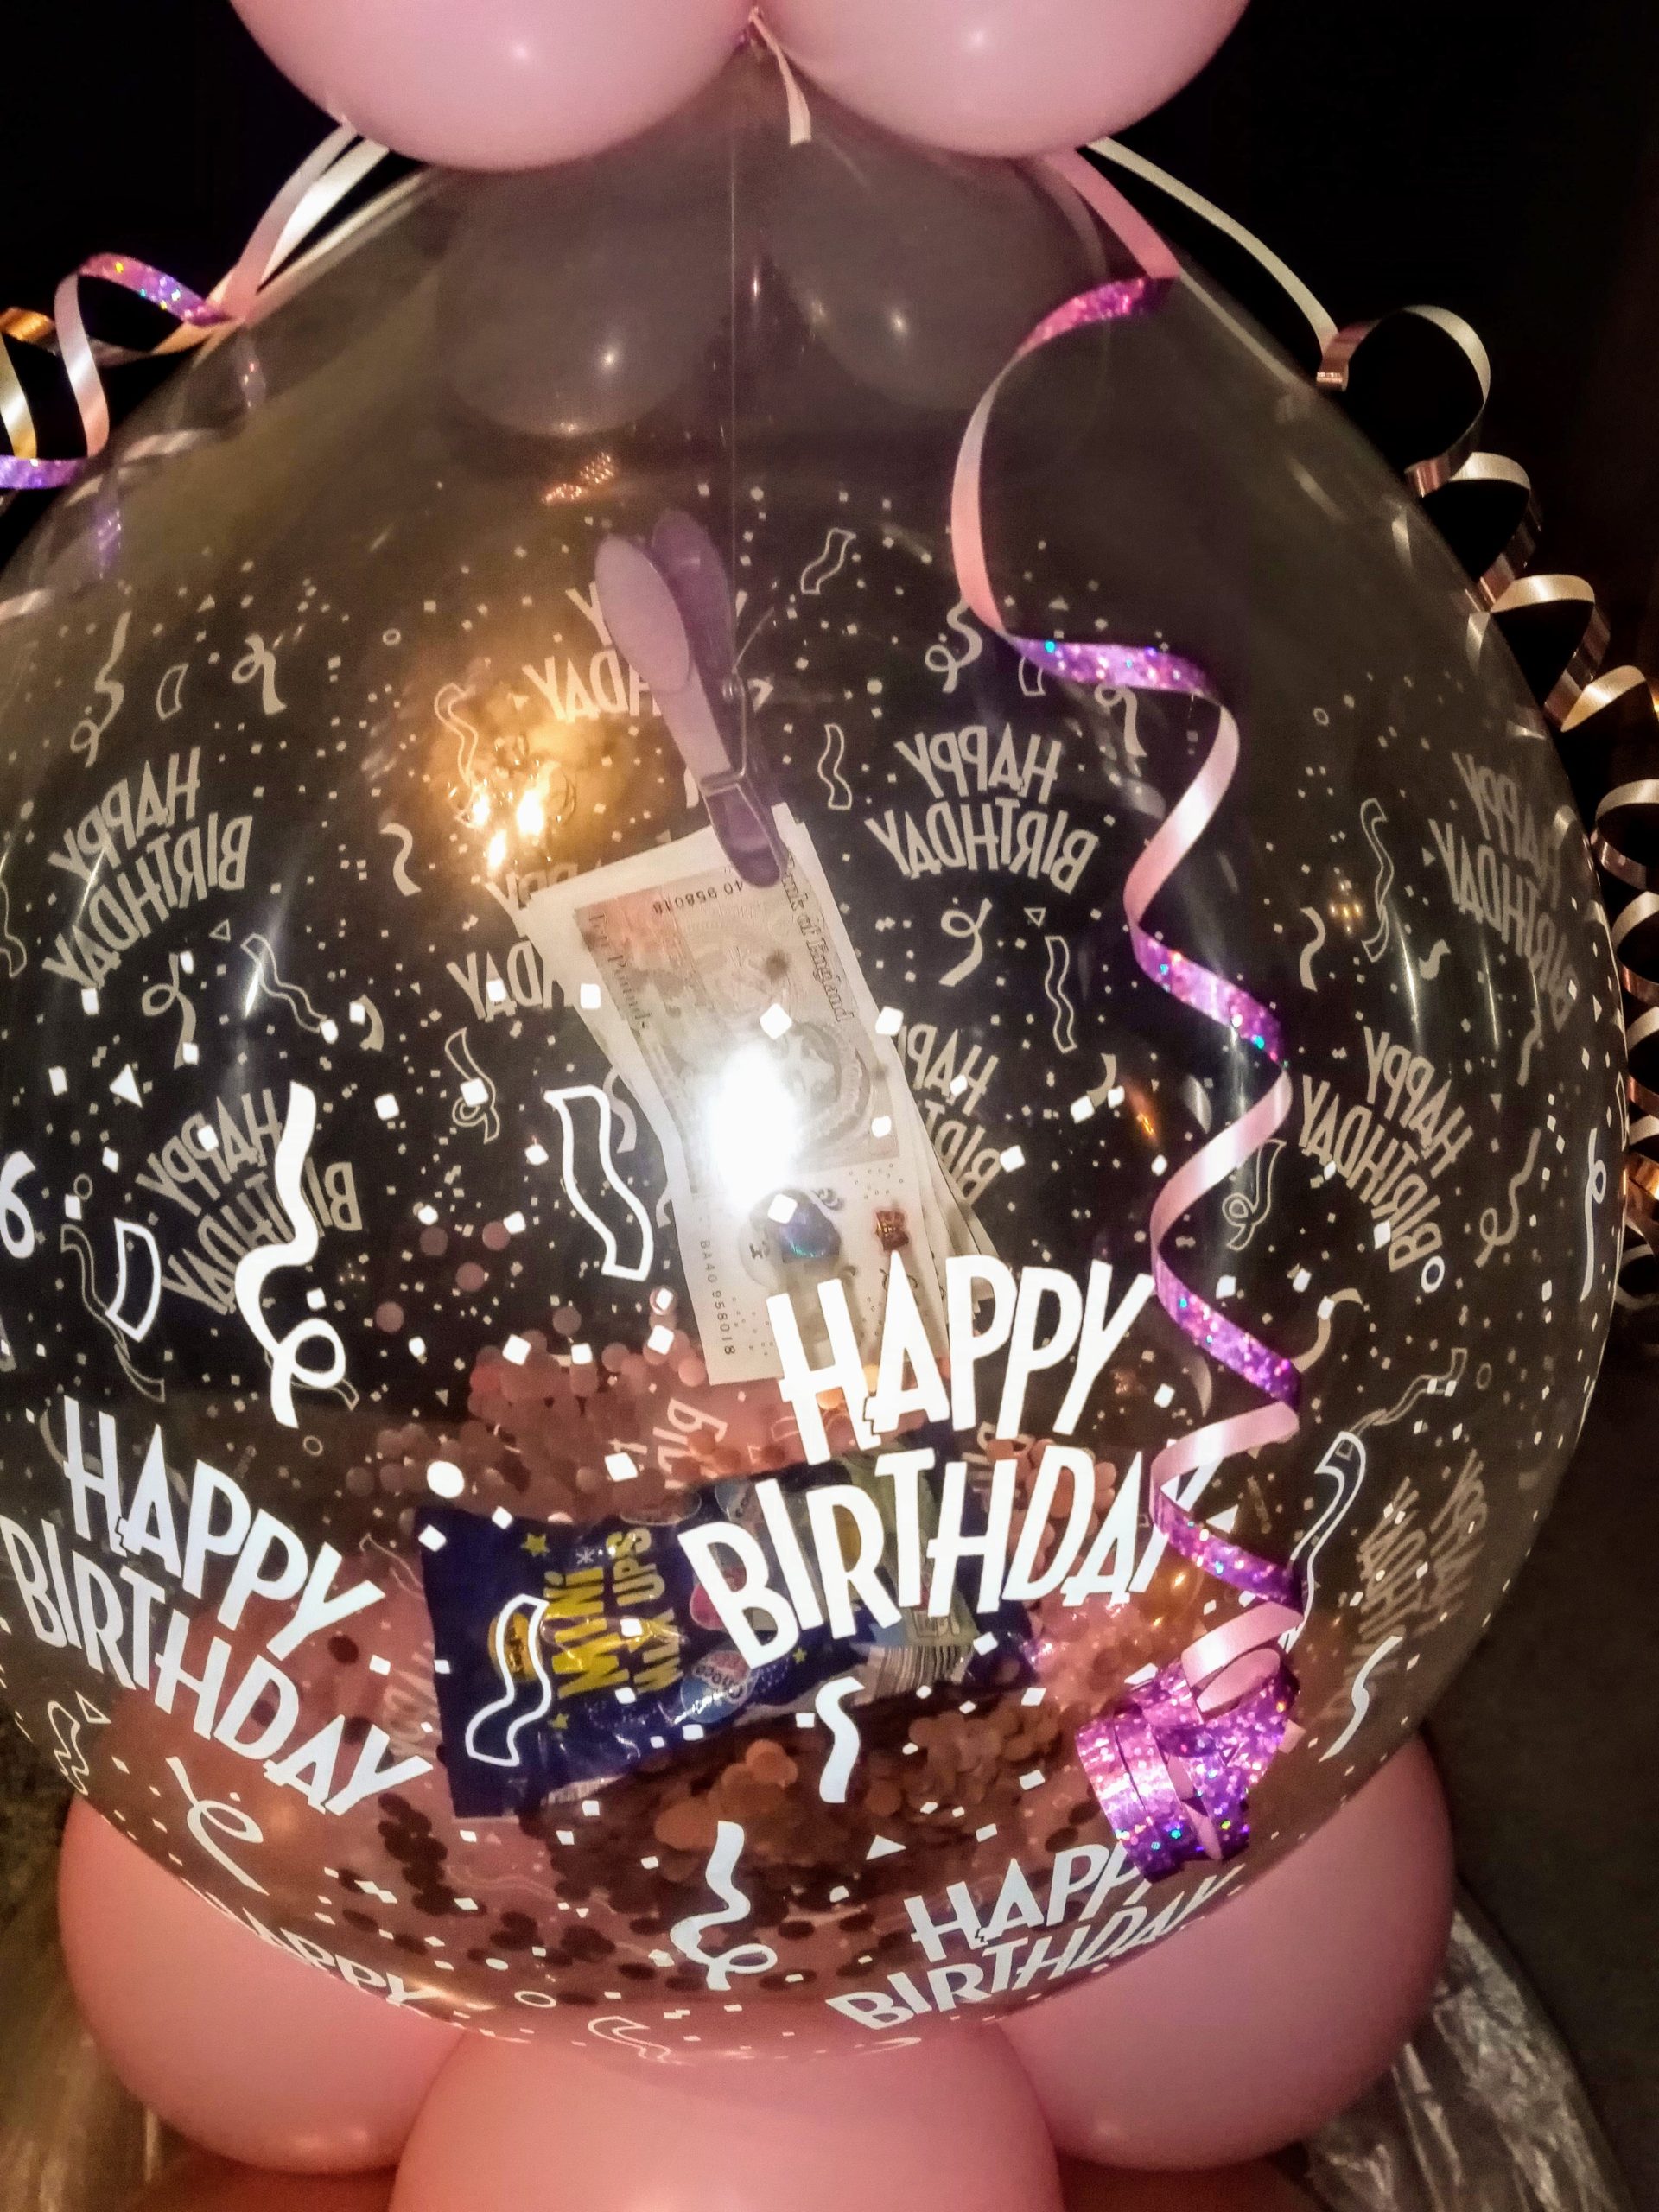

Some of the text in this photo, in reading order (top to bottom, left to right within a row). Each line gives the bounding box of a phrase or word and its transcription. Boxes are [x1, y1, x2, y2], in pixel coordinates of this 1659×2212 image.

[710, 1288, 737, 1356] 958018
[765, 1249, 1157, 1466] HAPPY
[62, 1395, 386, 1661] HAPPY
[605, 1527, 665, 1607] UPS
[0, 1515, 433, 1817] BIRTHDAY
[825, 1863, 1246, 2030] BIRTHDAY
